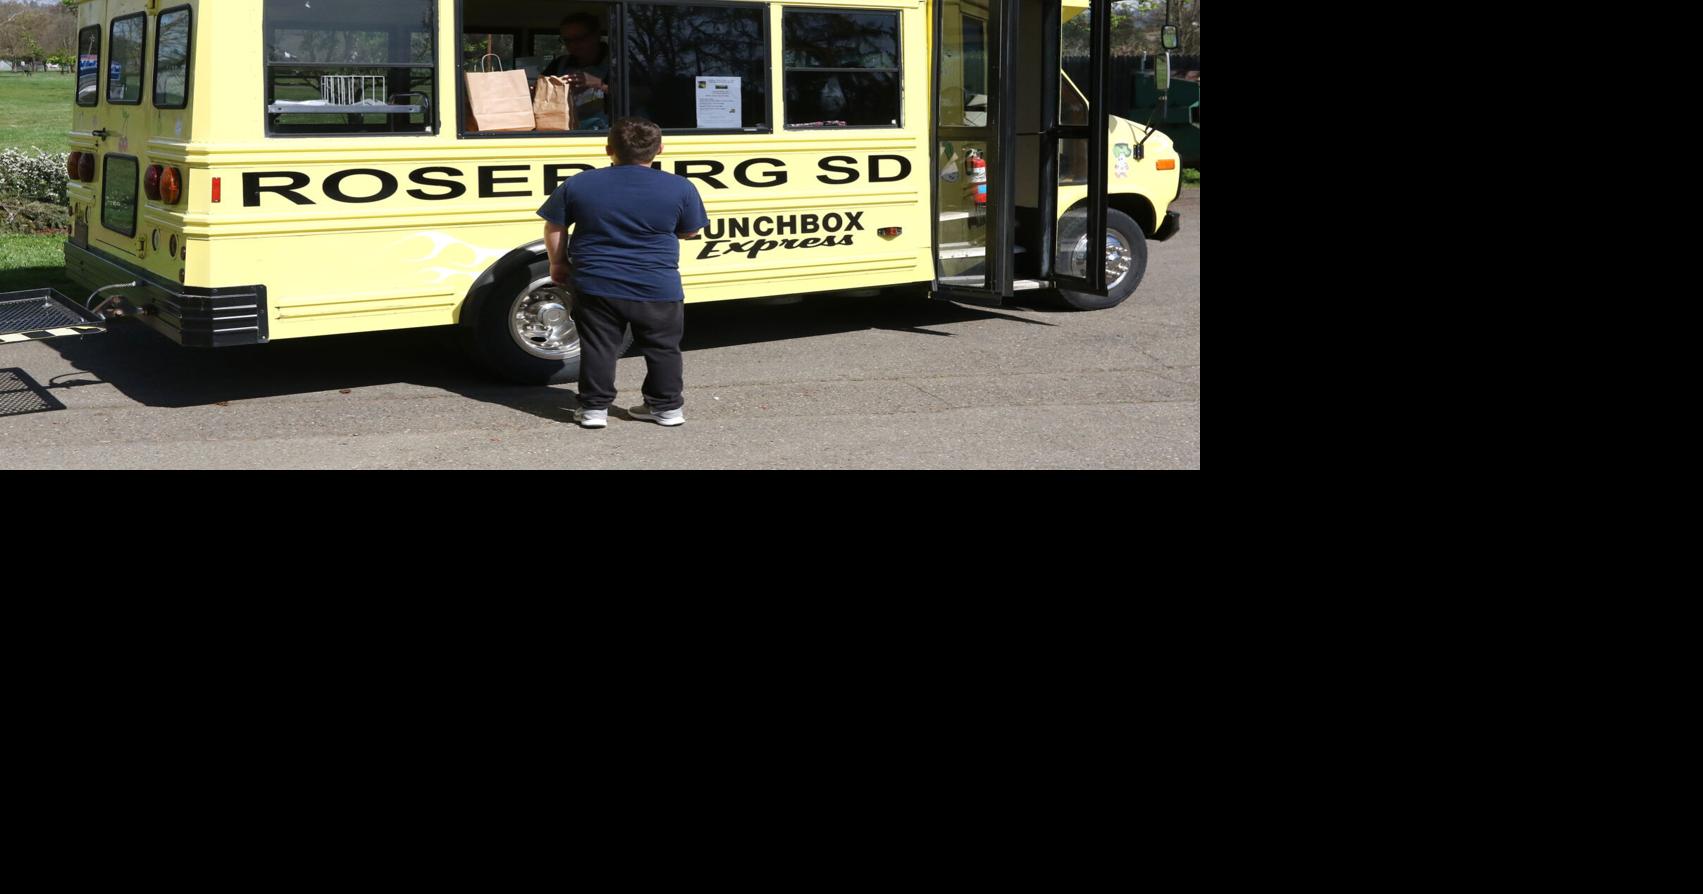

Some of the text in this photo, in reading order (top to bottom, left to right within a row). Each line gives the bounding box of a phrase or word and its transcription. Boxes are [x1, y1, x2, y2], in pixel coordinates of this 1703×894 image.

[242, 154, 912, 207] ROSERG SD
[685, 211, 865, 240] UNCHBOX
[696, 234, 854, 260] Express
